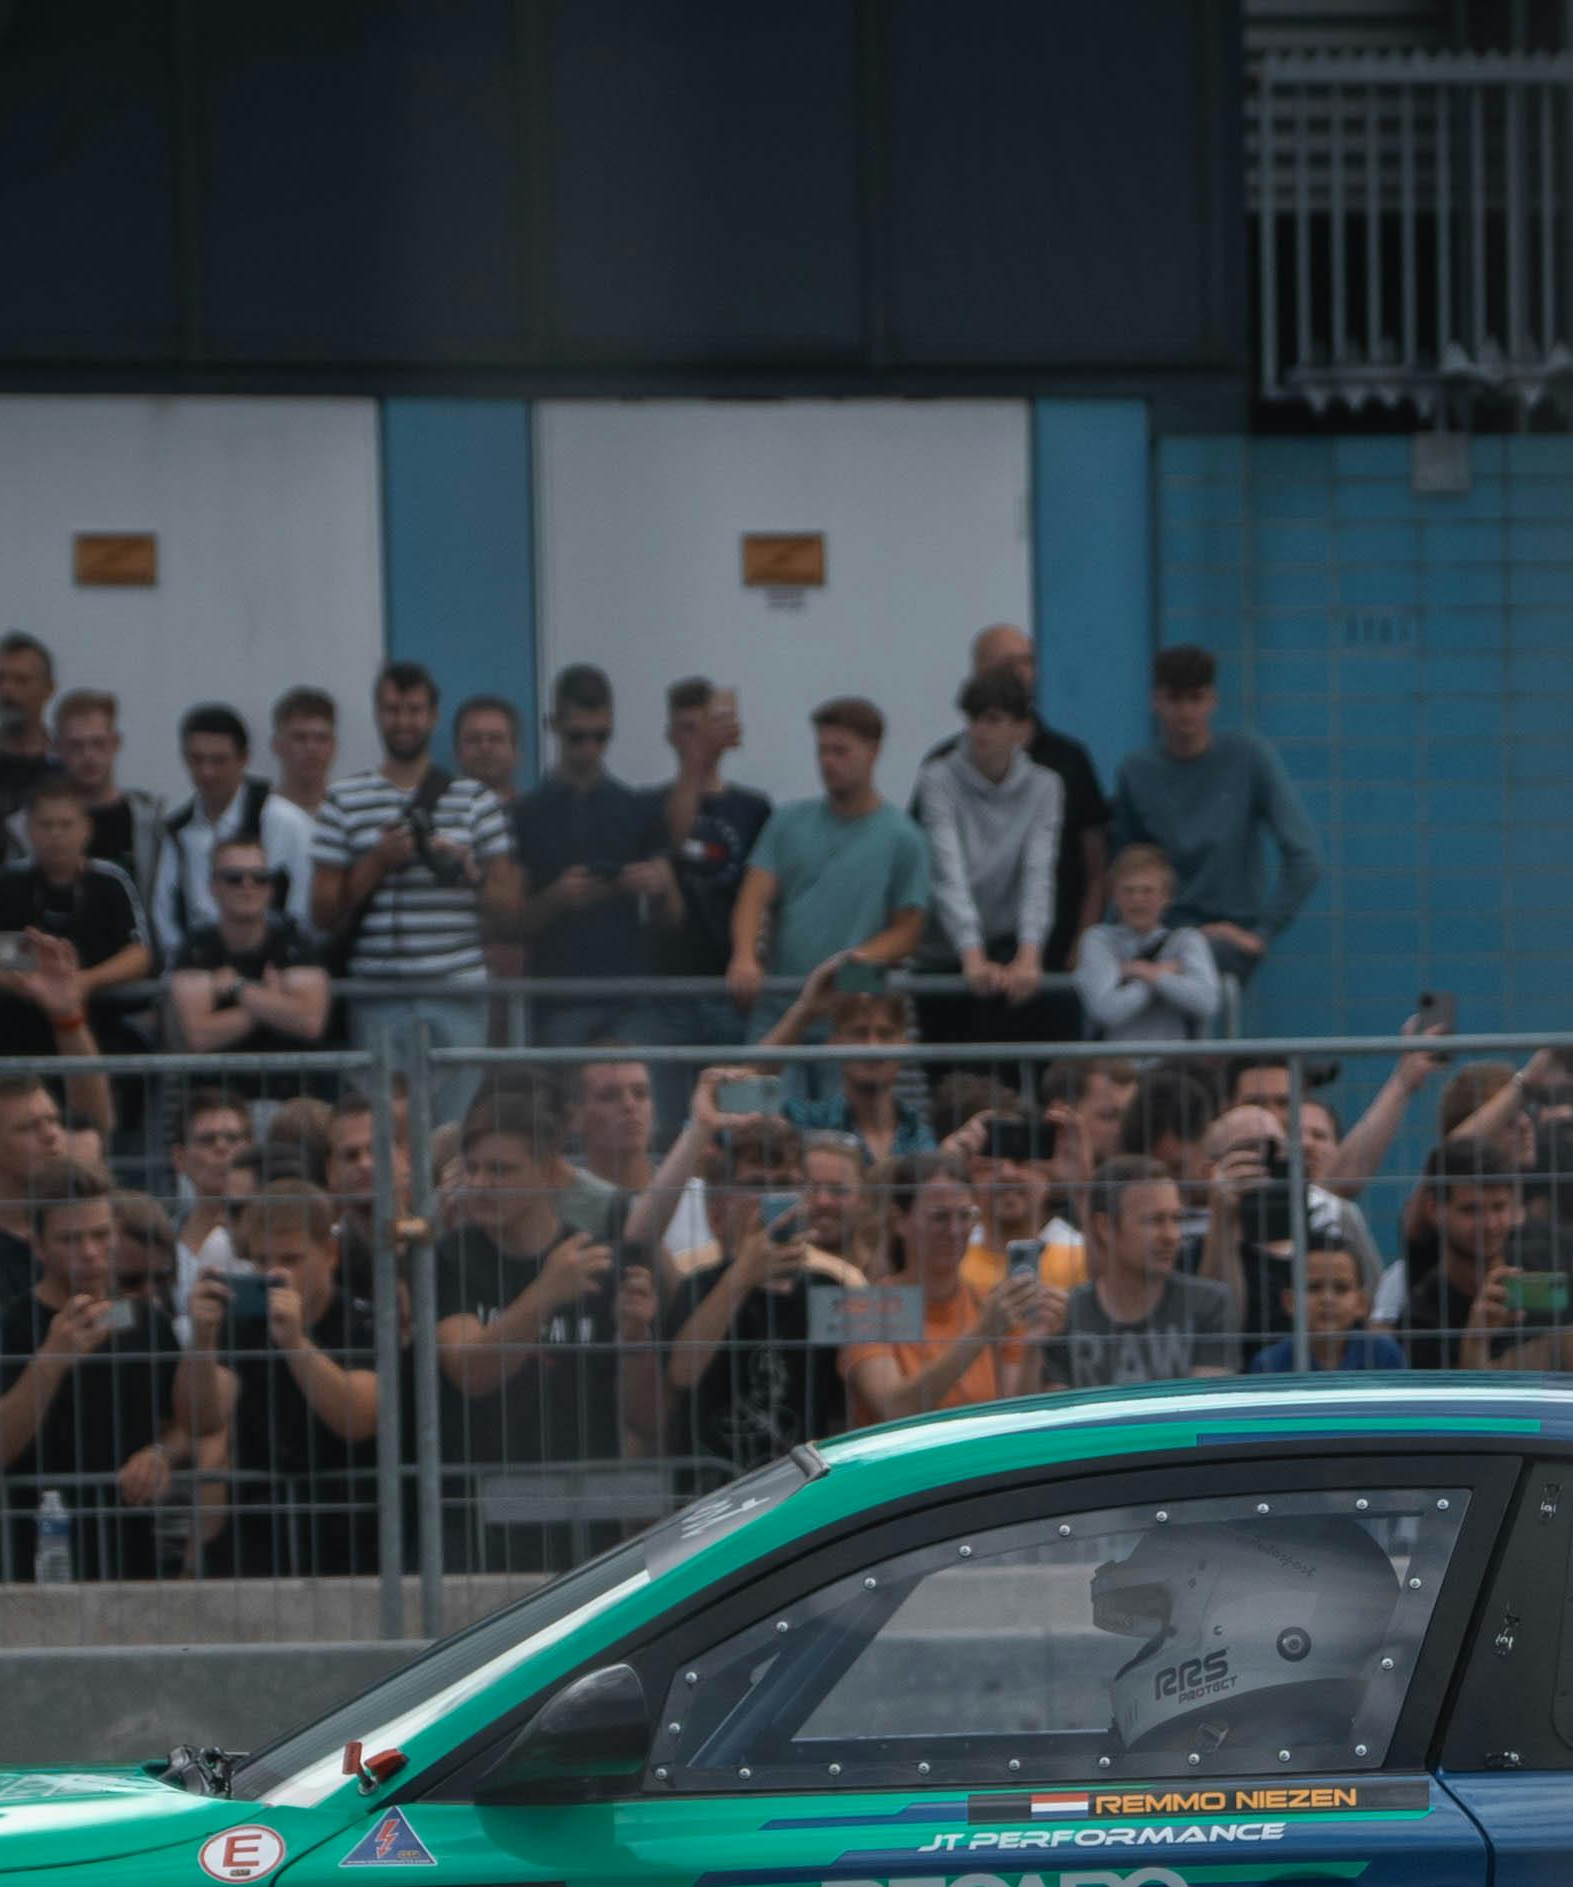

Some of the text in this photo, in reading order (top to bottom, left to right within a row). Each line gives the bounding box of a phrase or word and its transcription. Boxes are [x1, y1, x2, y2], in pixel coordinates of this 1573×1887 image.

[1071, 1325, 1196, 1388] RAW
[1155, 1649, 1229, 1701] RRS
[1178, 1675, 1238, 1704] PROTECT
[1095, 1788, 1357, 1815] REMMO NIEZEN
[222, 1834, 262, 1868] E
[917, 1823, 1286, 1852] JT PERFORMANCE
